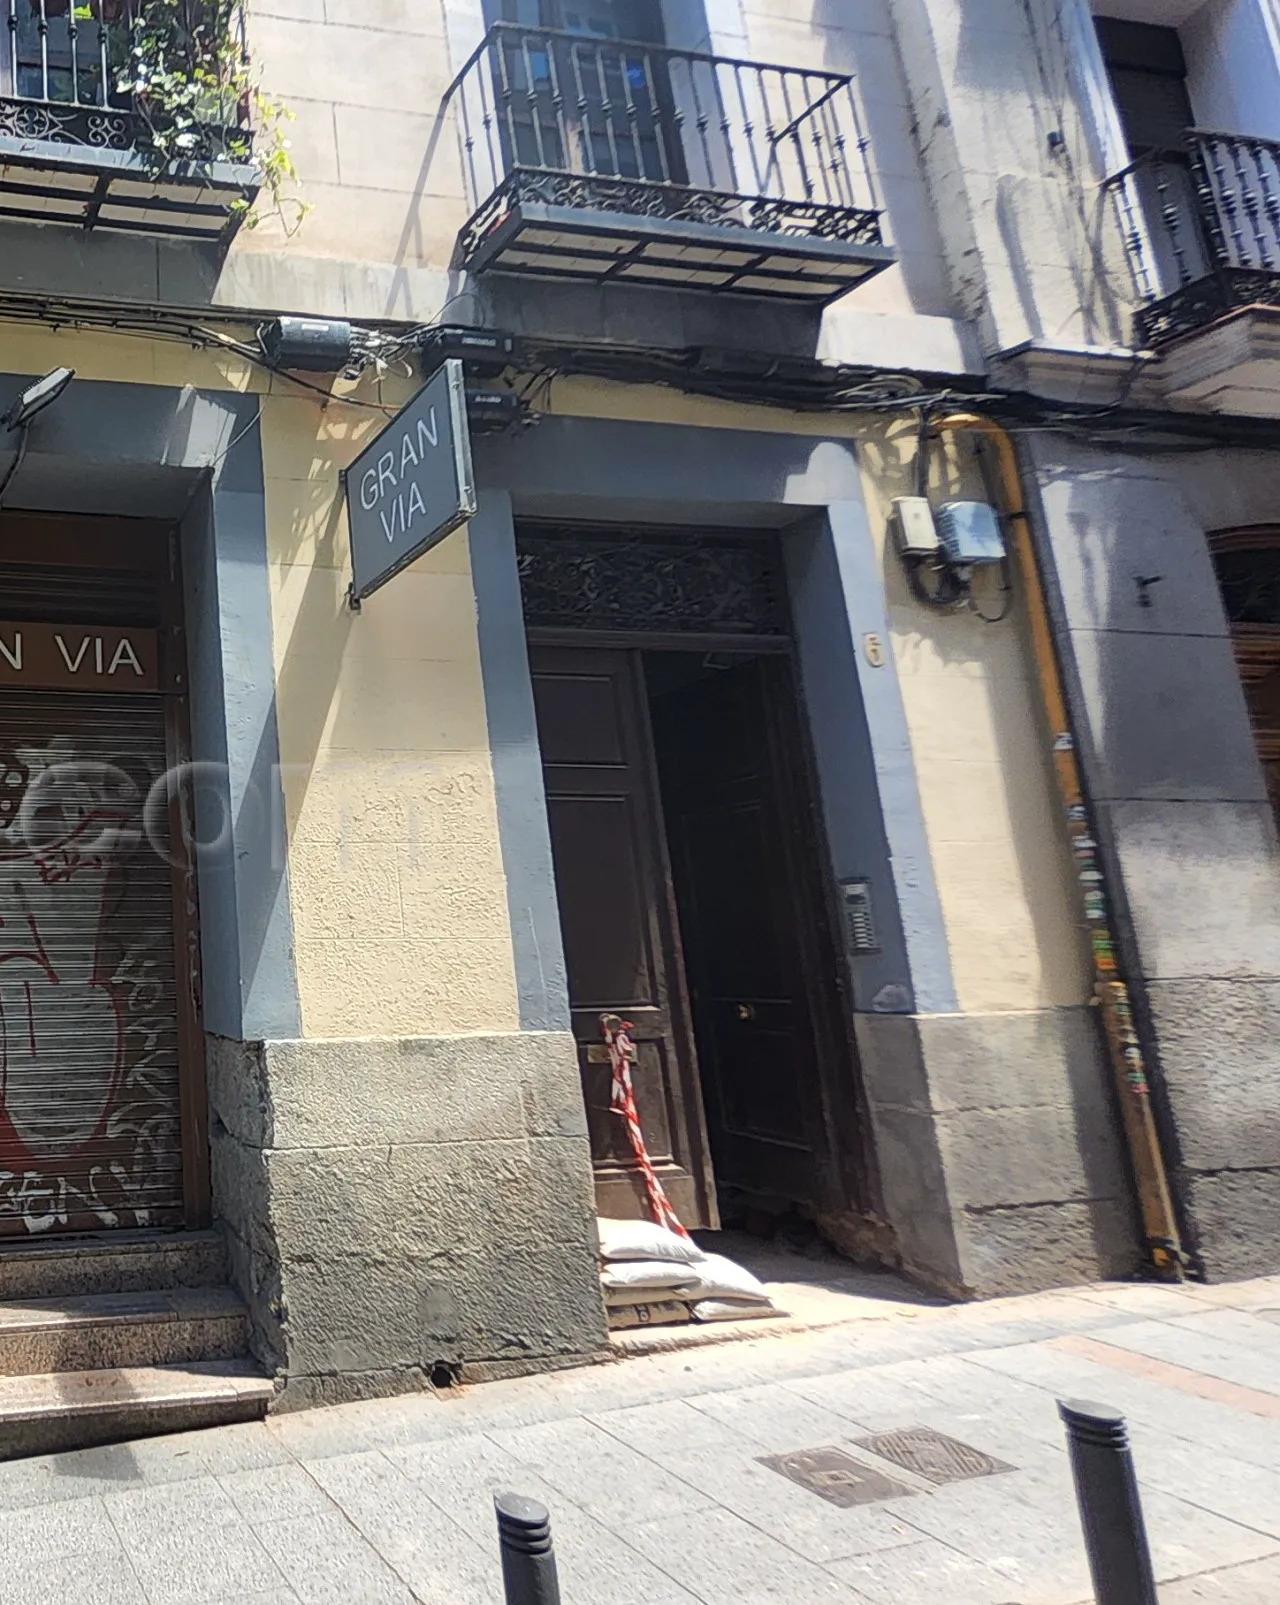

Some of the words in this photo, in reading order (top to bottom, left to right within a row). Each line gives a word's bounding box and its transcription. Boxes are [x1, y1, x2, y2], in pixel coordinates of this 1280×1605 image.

[360, 406, 439, 510] GRAN
[380, 482, 427, 543] VIA
[54, 634, 144, 675] VIA
